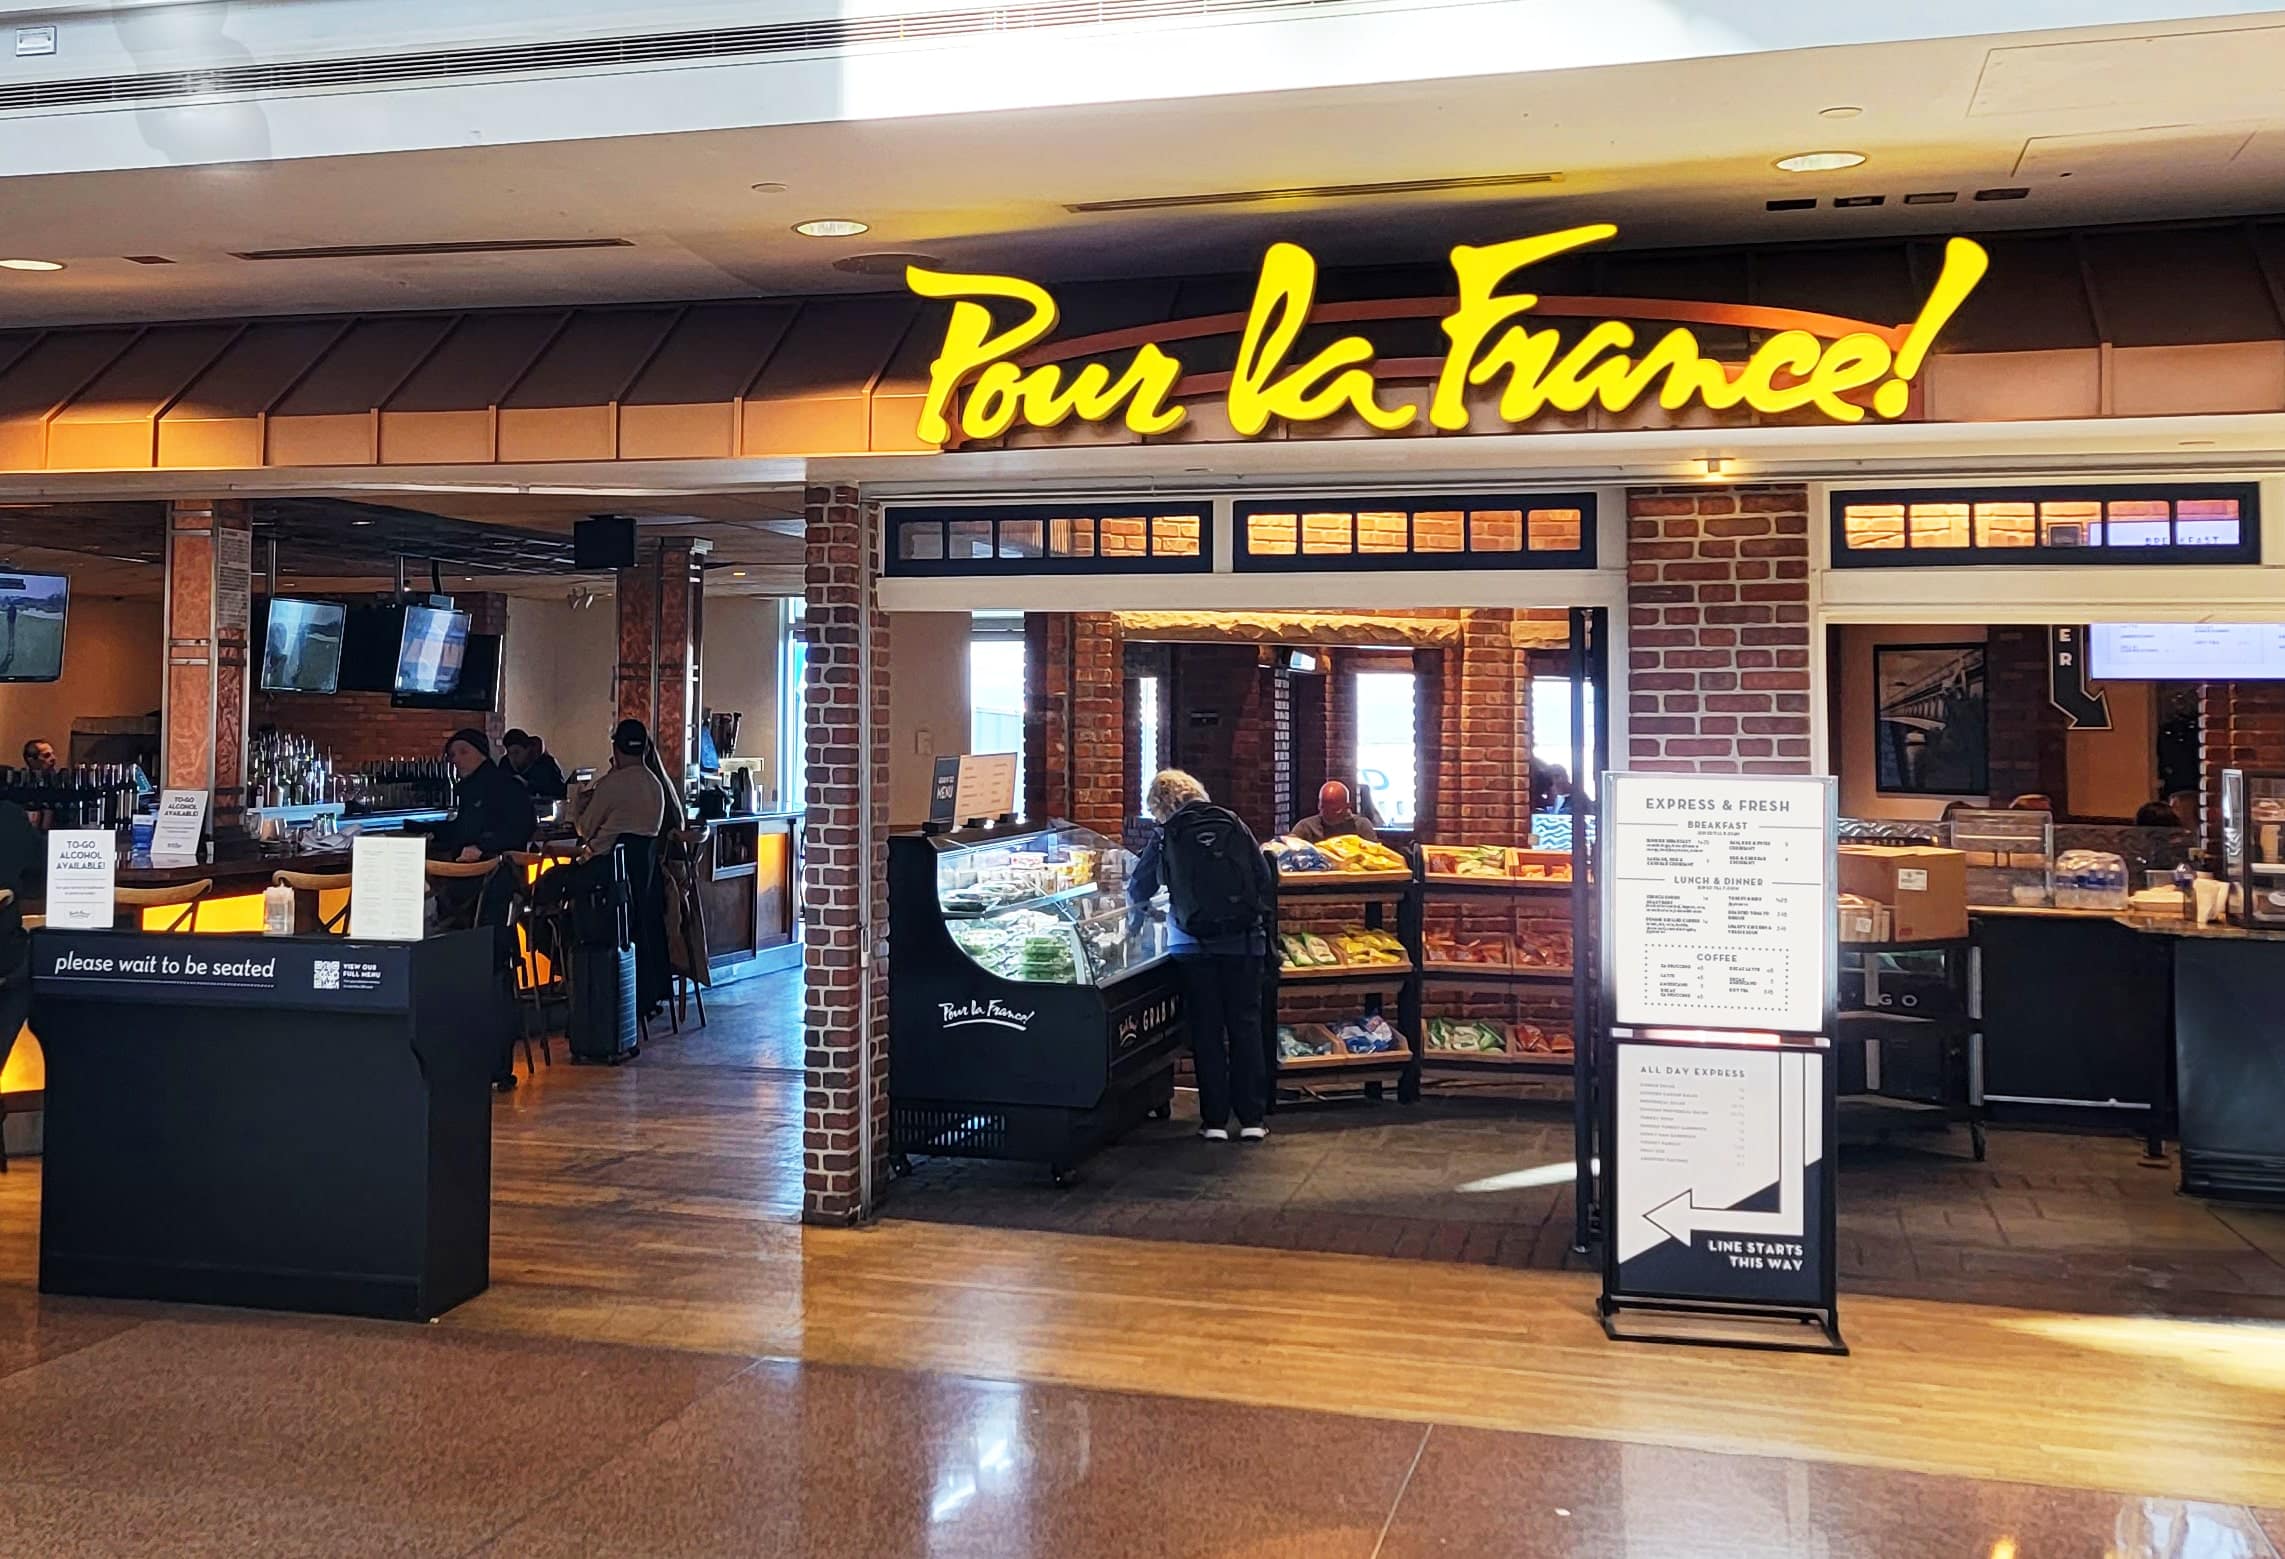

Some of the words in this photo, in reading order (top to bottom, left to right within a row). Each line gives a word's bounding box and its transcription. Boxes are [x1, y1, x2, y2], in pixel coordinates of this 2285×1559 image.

[906, 264, 1186, 444] Pour
[1227, 242, 1417, 436] la
[1429, 223, 1990, 431] France!
[1645, 798, 1716, 810] EXPRESS
[1722, 799, 1733, 811] &
[1739, 800, 1790, 812] FRESH
[1687, 820, 1748, 830] BREAKFAST
[66, 840, 96, 849] TO-GO
[59, 851, 103, 860] ALCOHOL
[55, 861, 106, 870] AVAILABLE!
[1673, 875, 1710, 885] LUNCH
[1713, 877, 1721, 885] &
[1724, 877, 1764, 886] DINNER
[1696, 953, 1738, 962] COFFEE
[55, 950, 114, 975] please
[118, 955, 157, 974] wait
[161, 956, 180, 974] to
[184, 955, 208, 975] be
[212, 957, 276, 978] seated
[343, 970, 360, 978] FULL
[938, 1002, 969, 1021] Pour
[971, 999, 985, 1016] la
[986, 999, 1035, 1025] France!
[1640, 1065, 1661, 1075] ALL
[1666, 1066, 1689, 1076] DAY
[1694, 1067, 1745, 1079] EXPRESS
[1708, 1239, 1743, 1254] LINE
[1747, 1241, 1804, 1257] STARTS
[1729, 1255, 1763, 1270] THIS
[1767, 1257, 1804, 1272] WAY
